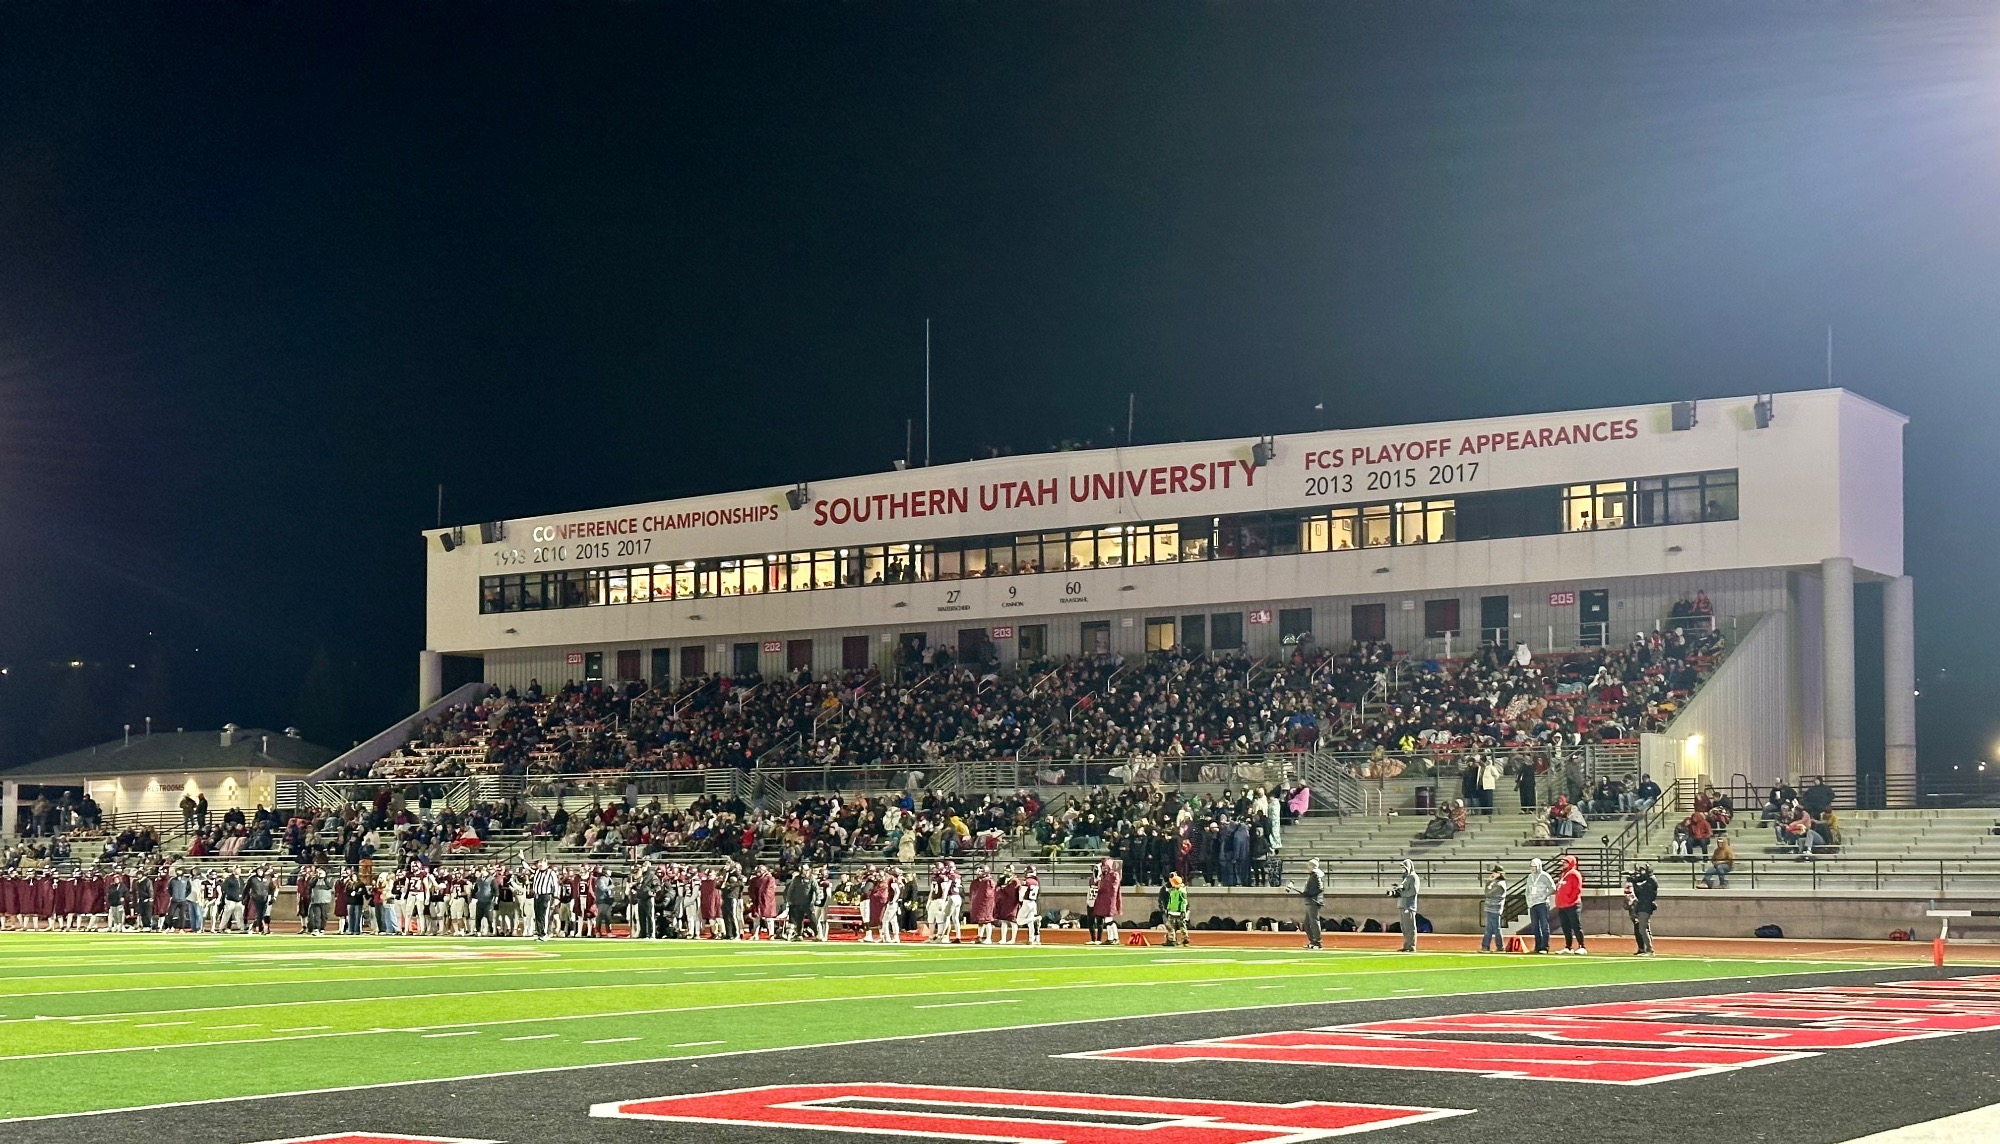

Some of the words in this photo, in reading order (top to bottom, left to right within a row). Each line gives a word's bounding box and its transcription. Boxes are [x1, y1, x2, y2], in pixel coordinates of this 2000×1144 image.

[1304, 449, 1344, 471] FCS
[1351, 437, 1452, 467] PLAYOFF
[1458, 418, 1639, 456] APPEARANCES
[1304, 473, 1353, 497] 2013
[1366, 467, 1416, 492] 2015
[1428, 462, 1480, 486] 2017
[813, 486, 969, 527] SOUTHERN
[979, 477, 1058, 512] UTAH
[1069, 459, 1257, 503] UNIVERSITY
[532, 517, 638, 543] CONFERENCE
[642, 504, 780, 533] CHAMPIONSHIPS
[533, 545, 567, 563] 2010
[575, 542, 610, 561] 2015
[617, 538, 652, 557] 2017
[1008, 586, 1017, 599] 9
[1065, 581, 1081, 595] 60
[946, 590, 961, 604] 27
[1550, 593, 1574, 605] 205
[993, 628, 1012, 638] 203
[764, 642, 781, 652] 202
[568, 654, 582, 663] 201
